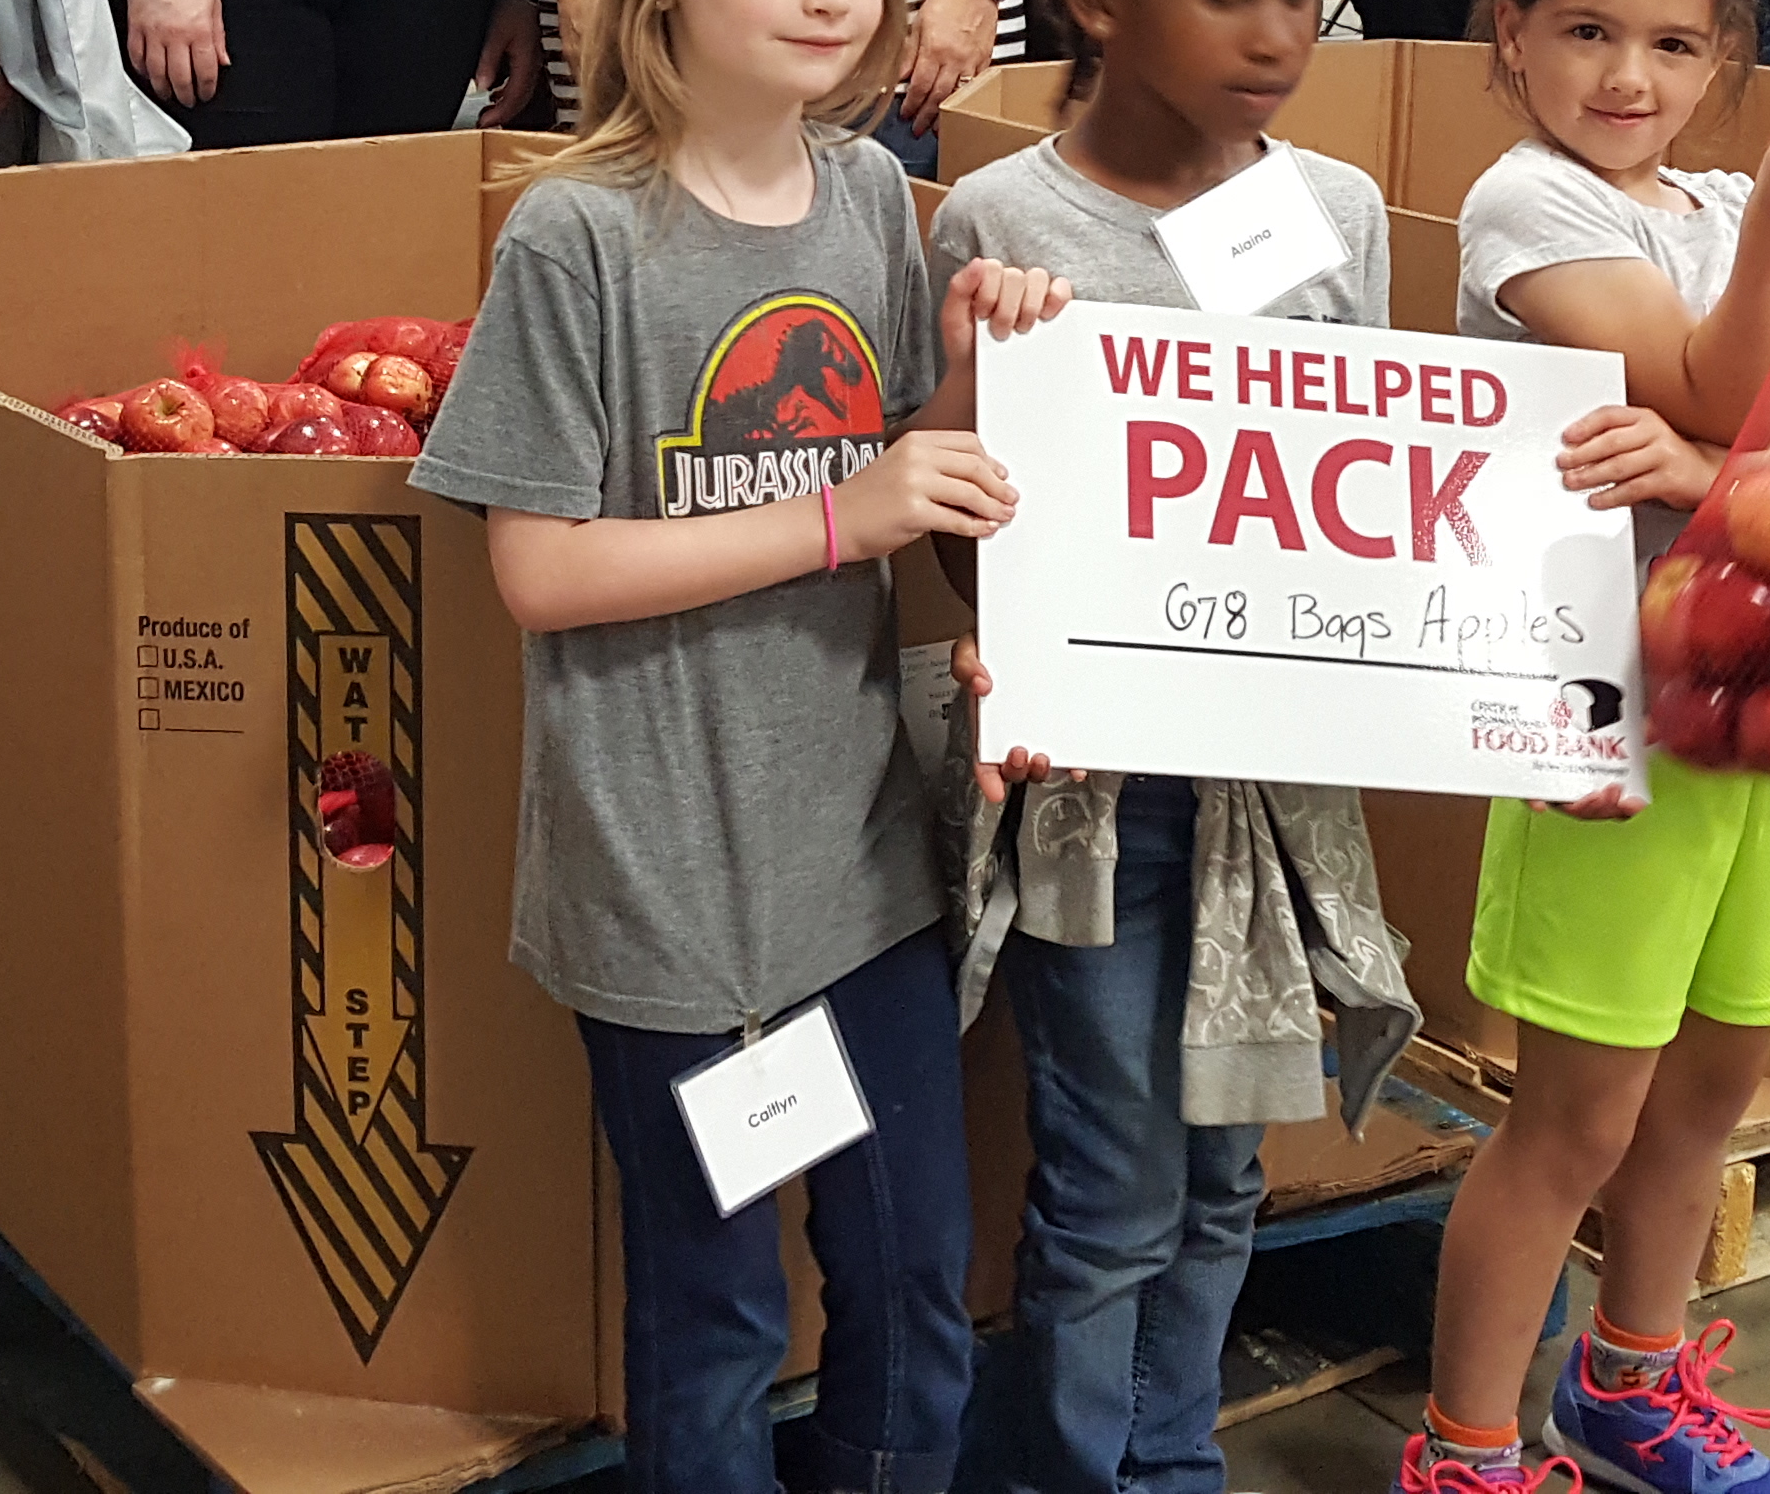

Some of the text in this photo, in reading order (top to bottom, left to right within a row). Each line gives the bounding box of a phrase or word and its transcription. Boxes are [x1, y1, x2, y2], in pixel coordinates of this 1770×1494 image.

[1231, 228, 1282, 260] Alaina
[1098, 333, 1509, 429] WE HELPED
[667, 445, 837, 518] JURASSIC
[1125, 419, 1495, 568] PACK
[137, 614, 251, 639] Produce of
[1165, 581, 1586, 674] 678 Bags Apples
[162, 647, 225, 670] U.S.A.
[163, 679, 246, 703] MEXICO
[1471, 726, 1550, 756] FOOD
[747, 1093, 799, 1129] Caitlyn
